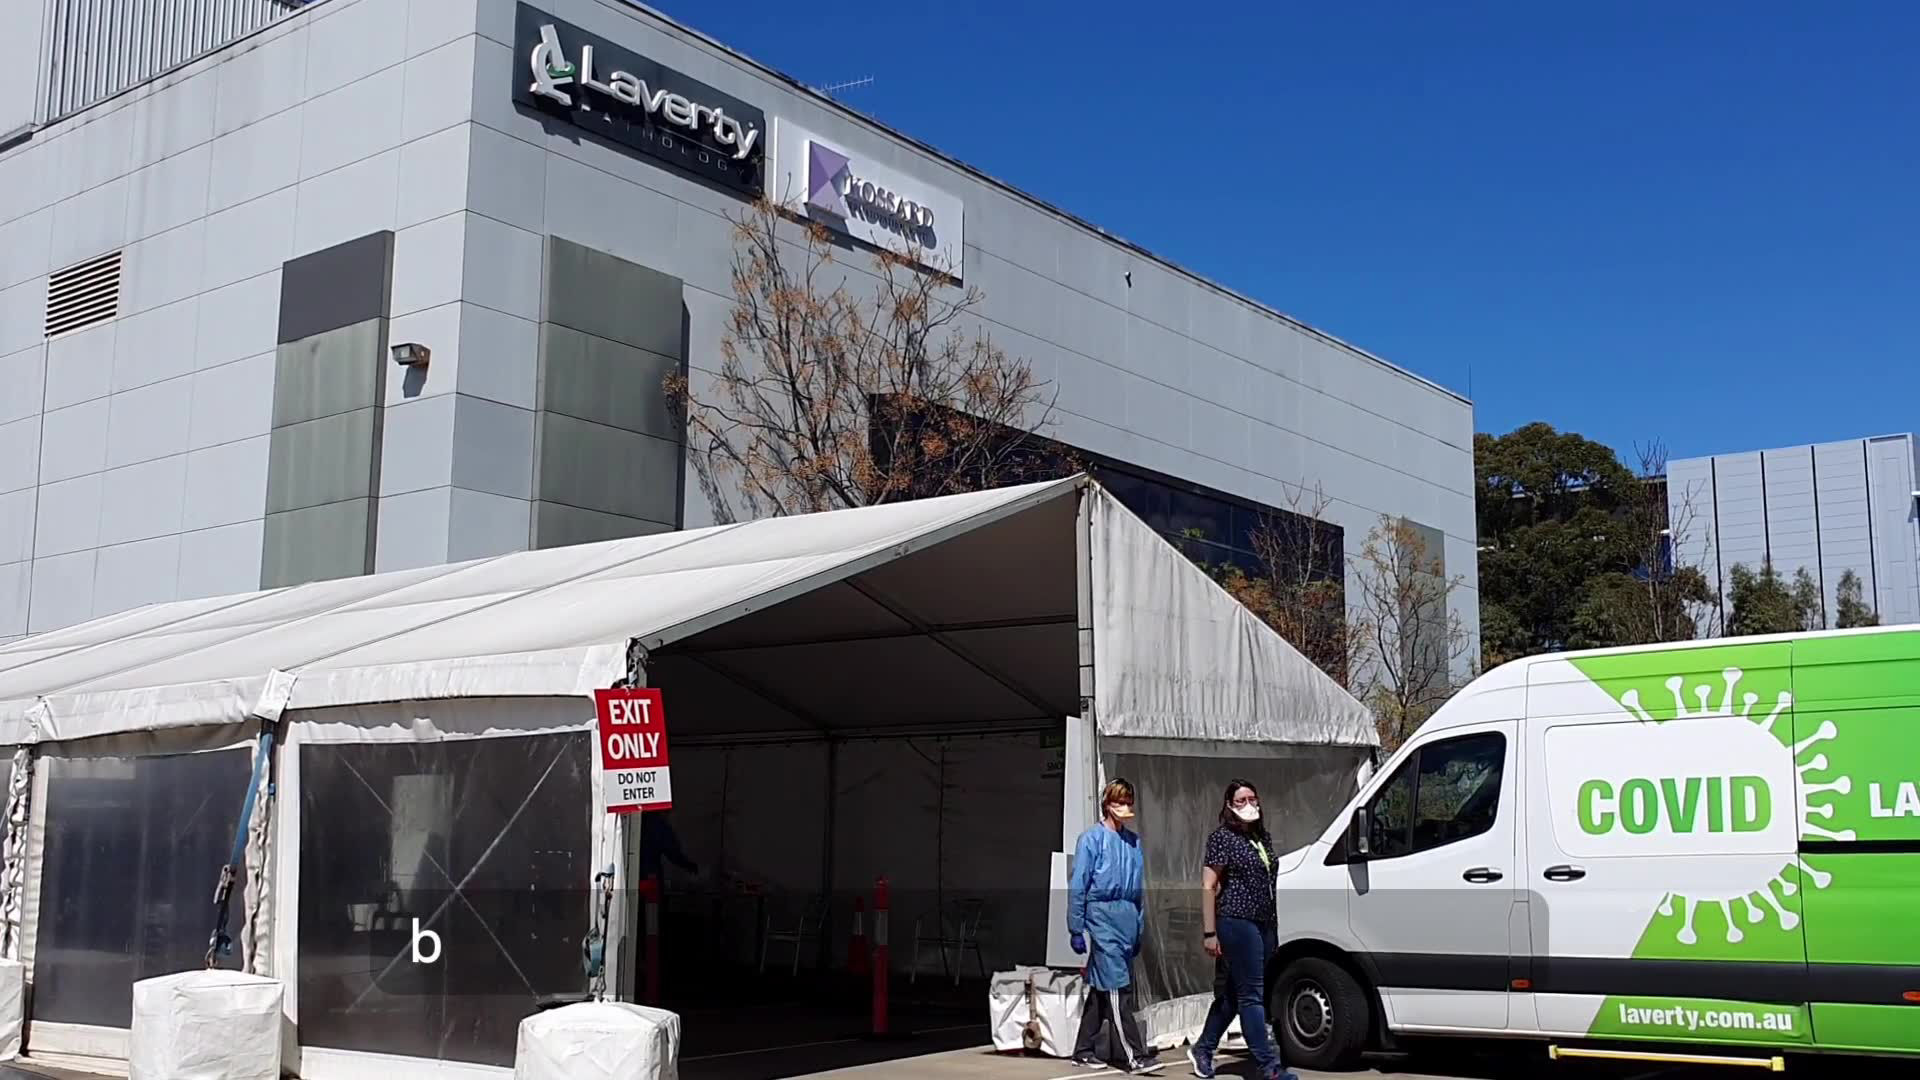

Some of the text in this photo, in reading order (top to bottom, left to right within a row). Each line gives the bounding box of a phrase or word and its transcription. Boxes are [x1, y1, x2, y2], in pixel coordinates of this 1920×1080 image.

[581, 44, 759, 160] Laverty
[843, 175, 935, 228] KOSSARD
[608, 699, 651, 725] EXIT
[607, 732, 660, 760] ONLY
[618, 771, 656, 785] DO NOT
[623, 787, 655, 801] ENTER
[1577, 776, 1772, 835] COVID
[1619, 1003, 1793, 1031] laverty.com.au
